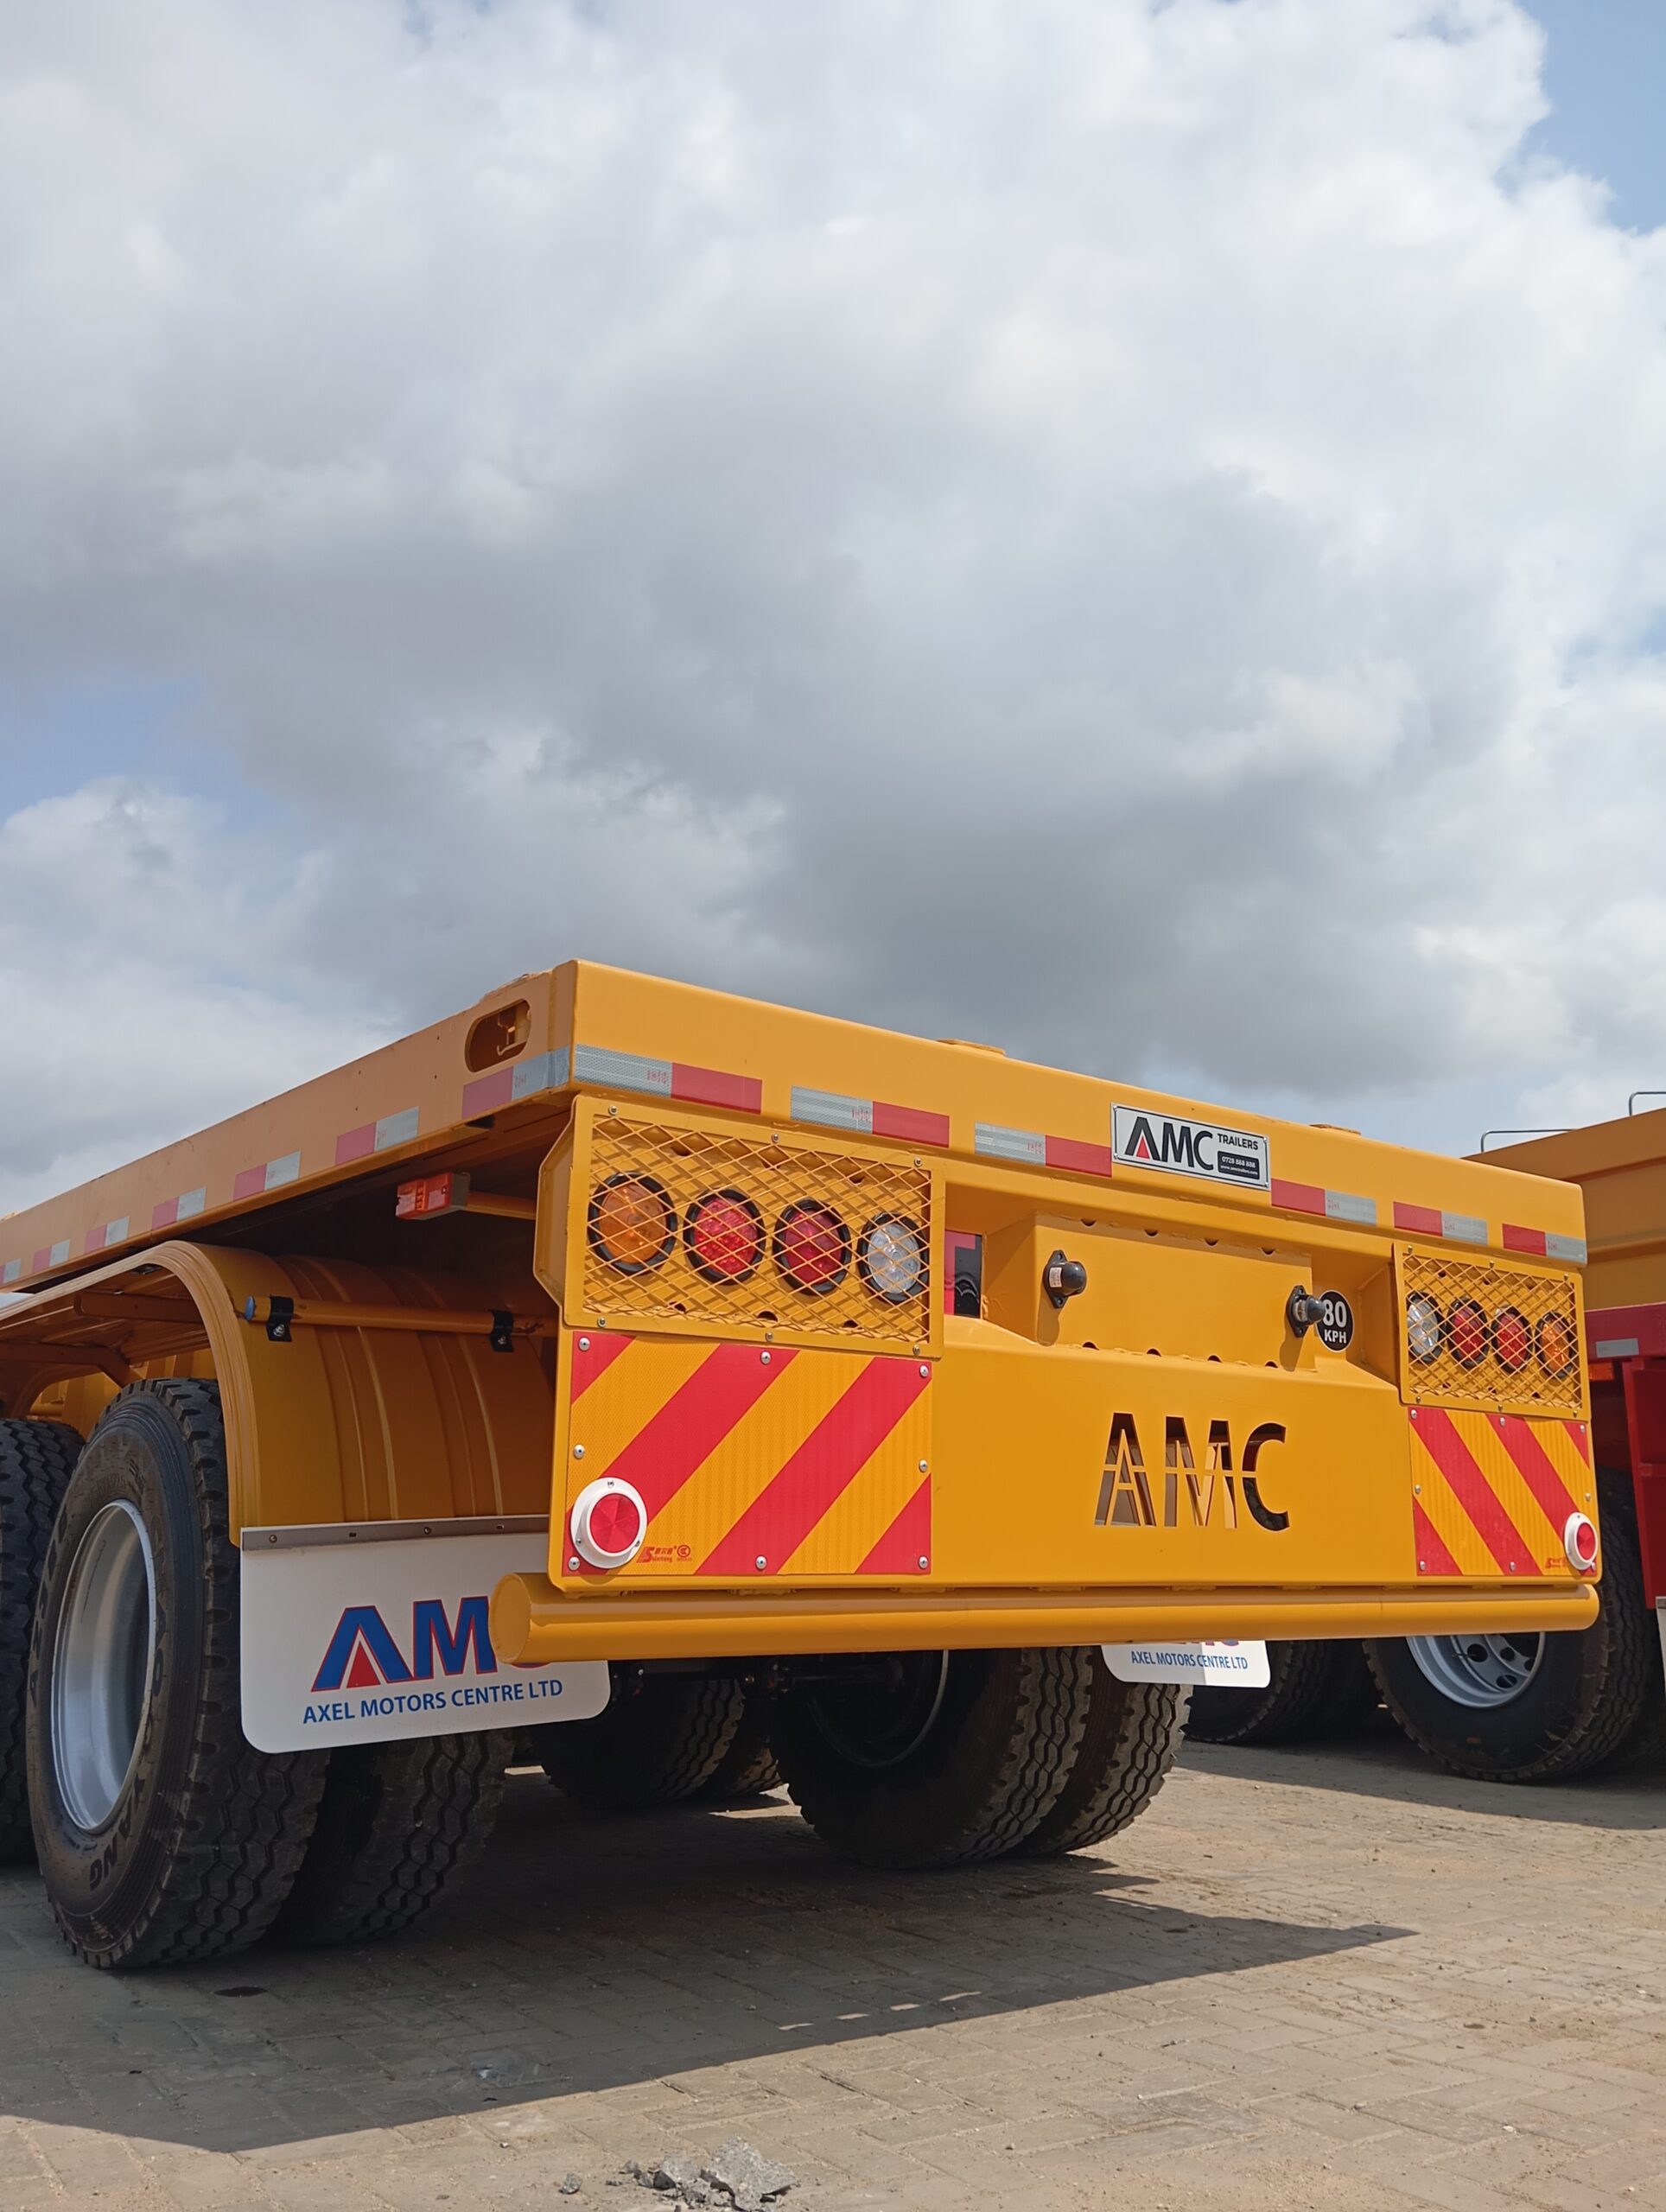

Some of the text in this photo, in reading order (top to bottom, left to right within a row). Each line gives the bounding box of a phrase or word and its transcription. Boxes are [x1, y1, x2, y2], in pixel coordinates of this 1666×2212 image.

[1124, 1116, 1214, 1171] AMC
[1217, 1133, 1259, 1151] TRAILERS
[1322, 1299, 1347, 1328] 80
[1324, 1329, 1347, 1344] KPH
[1094, 1412, 1290, 1532] AMC
[311, 1595, 553, 1694] AM
[1130, 1650, 1249, 1670] AXEL MOTORS CENTRE LTD
[302, 1678, 563, 1724] AXEL MOTORS CENTRE LTD
